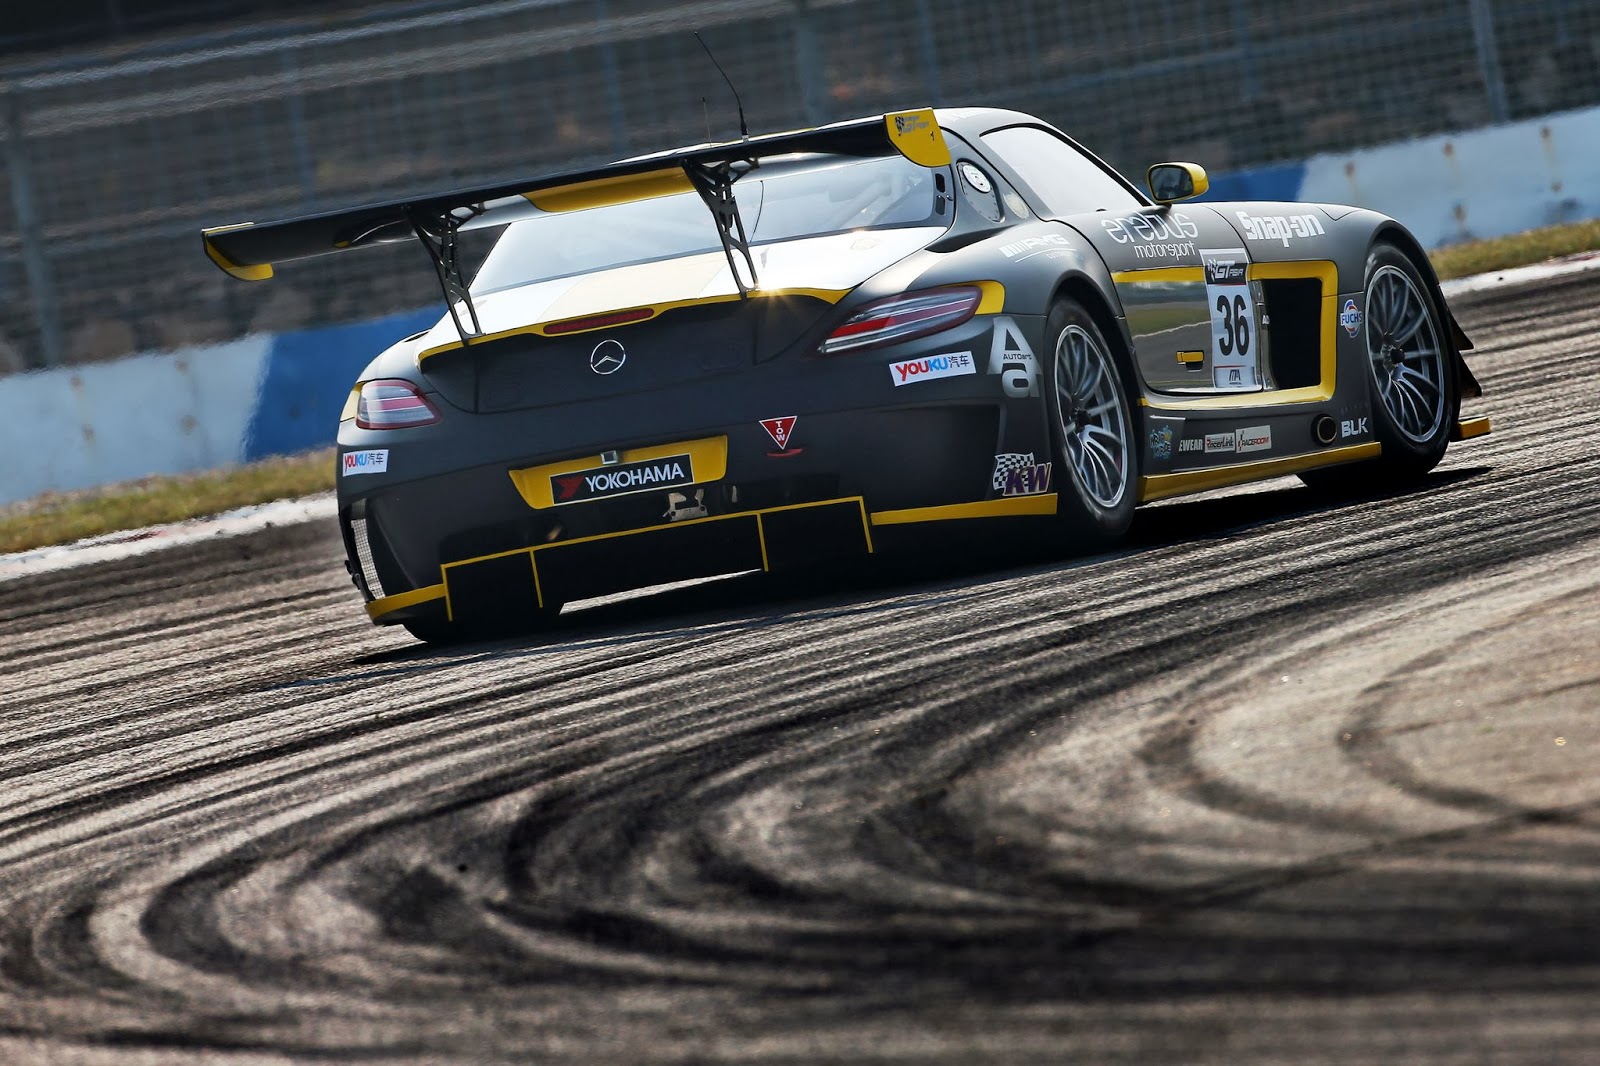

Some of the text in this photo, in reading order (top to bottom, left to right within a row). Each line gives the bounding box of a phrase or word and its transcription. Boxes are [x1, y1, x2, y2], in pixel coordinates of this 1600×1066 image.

[1101, 210, 1198, 244] erebus
[1235, 211, 1325, 247] Snap-on
[1134, 241, 1196, 261] motorsport
[1216, 294, 1250, 356] 36
[1341, 312, 1363, 325] FUCHS
[1003, 353, 1032, 361] AUTOart
[775, 420, 786, 442] TOW
[1341, 417, 1369, 438] BLK
[1178, 439, 1203, 452] EWEAR
[585, 462, 685, 493] YOKOHAMA
[1003, 462, 1052, 496] KW
